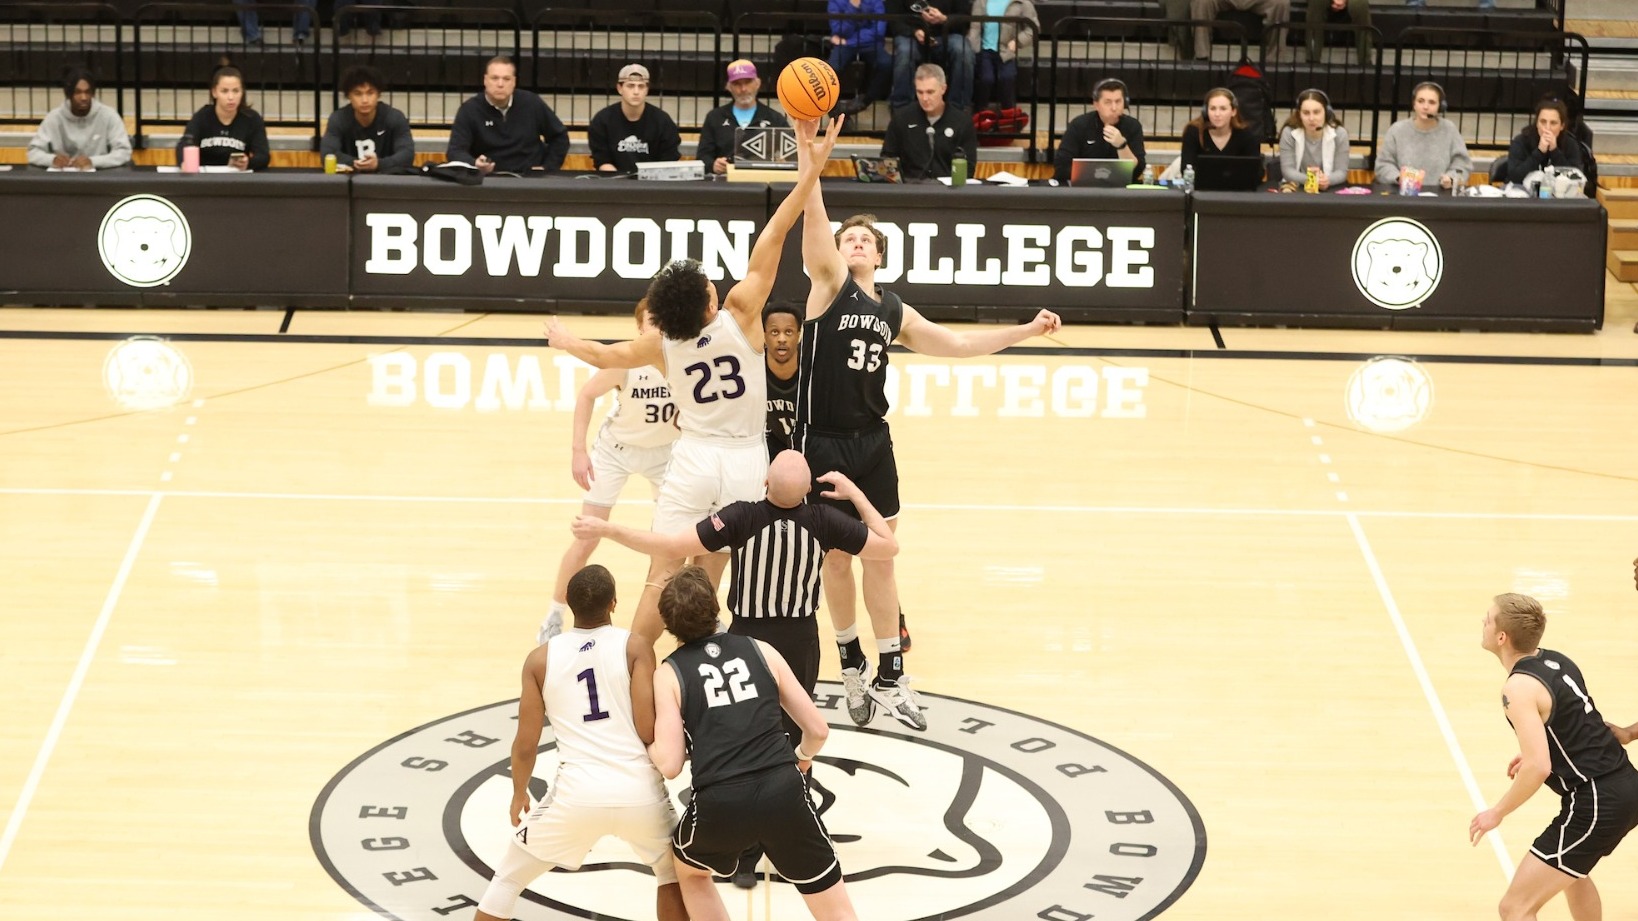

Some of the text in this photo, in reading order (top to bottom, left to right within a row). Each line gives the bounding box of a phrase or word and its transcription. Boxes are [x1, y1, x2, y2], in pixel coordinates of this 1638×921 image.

[801, 63, 826, 101] Wilson
[365, 213, 1155, 288] BOWDOIN OLLEGE
[847, 338, 883, 373] 33
[631, 386, 671, 399] AMHE
[684, 355, 746, 404] 23
[645, 402, 675, 424] 30
[577, 667, 610, 723] 1
[698, 656, 759, 708] 22
[1562, 673, 1594, 715] 1
[516, 826, 529, 845] A
[358, 805, 1158, 921] BOWD LEGE
